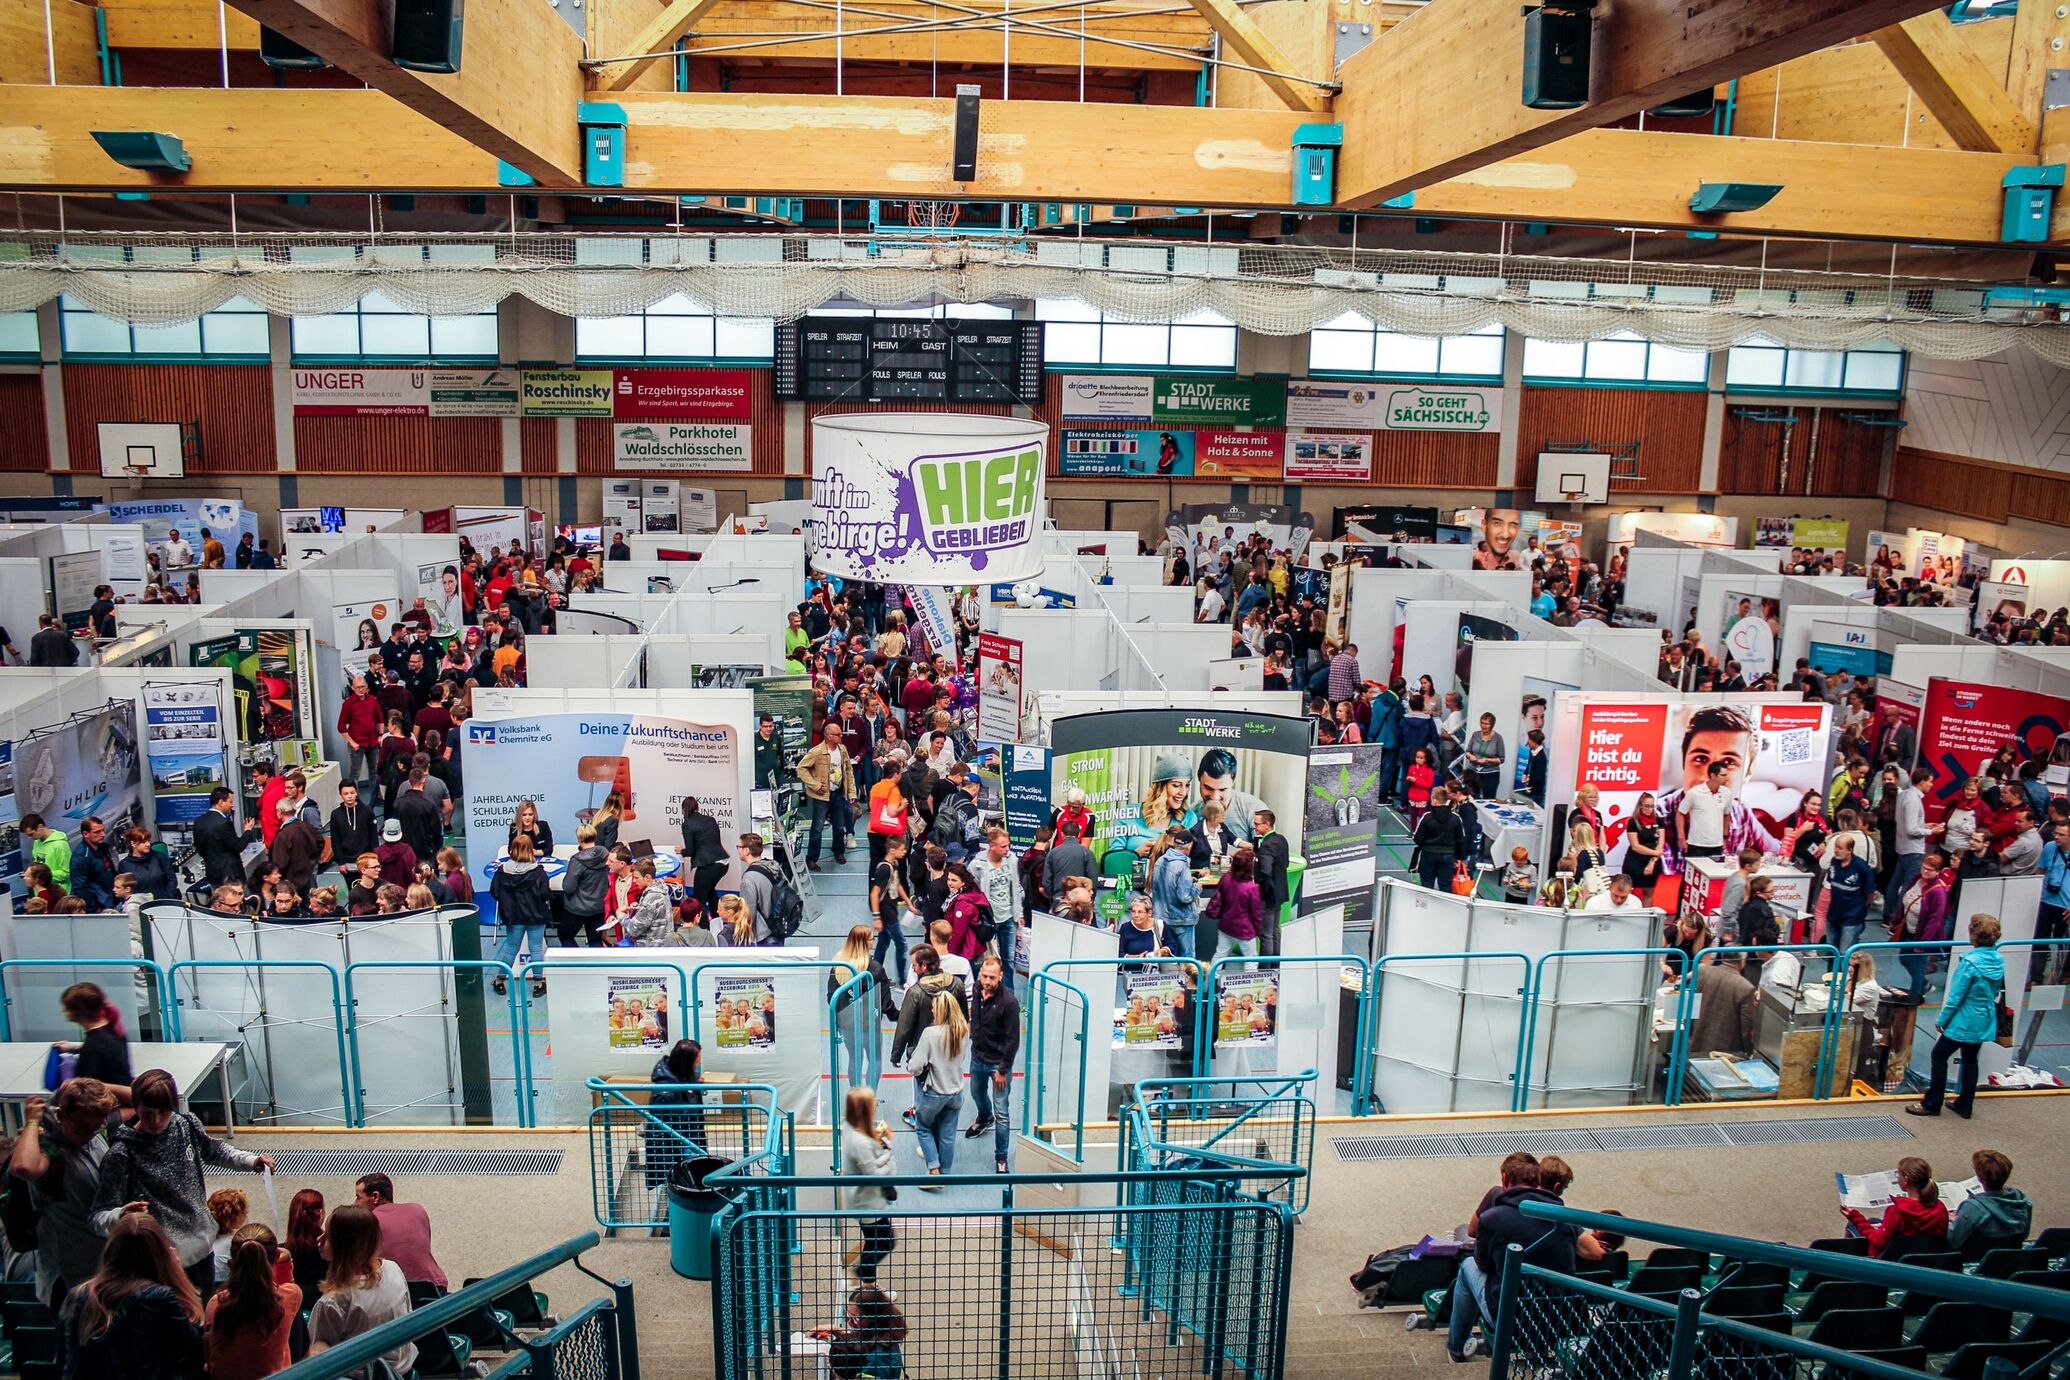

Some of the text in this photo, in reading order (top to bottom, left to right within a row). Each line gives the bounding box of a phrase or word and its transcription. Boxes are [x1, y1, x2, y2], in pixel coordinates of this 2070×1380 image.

[836, 333, 862, 341] STRAFZEIT
[891, 324, 931, 338] 10:45
[873, 342, 947, 350] HEIM GAST
[986, 336, 1012, 344] STRAFZEIT
[295, 373, 364, 389] UNGER
[524, 372, 580, 381] Fensterbau
[872, 371, 946, 379] FOULS SPIELER FOULS
[524, 384, 611, 401] Roschinsky
[638, 385, 744, 398] Erzgebirgssparkasse
[1170, 383, 1215, 396] STADT
[702, 401, 735, 409] Erzgebirge.
[1199, 397, 1251, 411] WERKE
[1418, 397, 1467, 408] SO GEHT
[357, 407, 425, 415] www.unger-elektro.de
[1394, 406, 1478, 424] SÄCHSISCH.
[670, 426, 737, 439] Parkhotel
[1214, 434, 1268, 445] Heizen mit
[625, 443, 743, 455] Waldschlösschen
[1207, 446, 1273, 457] Holz & Sonne
[919, 450, 1039, 527] HIER
[846, 483, 870, 509] im
[122, 503, 187, 517] SCHERDEL
[932, 519, 1026, 549] GEBLIEBEN
[981, 646, 1001, 656] Annaberg
[991, 641, 1009, 650] Schulen
[1184, 718, 1217, 728] STADT
[1941, 715, 2011, 731] Wenn andere noch
[499, 725, 541, 734] Volksbank
[580, 723, 728, 742] Deine Zukunftschance!
[1205, 728, 1241, 739] WERKE
[1950, 724, 1961, 733] die
[1962, 727, 1984, 736] Ferne
[1985, 729, 2026, 744] schweifen,
[499, 735, 552, 744] Chemnitz eG
[1589, 729, 1623, 745] Hier
[1939, 732, 1996, 746] findest du dein
[632, 739, 665, 749] Ausbildung
[681, 742, 706, 750] Studium
[1937, 740, 1952, 749] Ziel
[1953, 743, 1969, 751] zum
[1587, 747, 1642, 763] bist du
[1071, 758, 1105, 774] STROM
[1585, 765, 1641, 785] richtig.
[1061, 779, 1079, 793] GAS
[64, 783, 108, 810] UHLIG
[472, 794, 545, 804] JAHRELANG DIE
[697, 797, 733, 805] KANNST
[665, 806, 733, 817] DU AM
